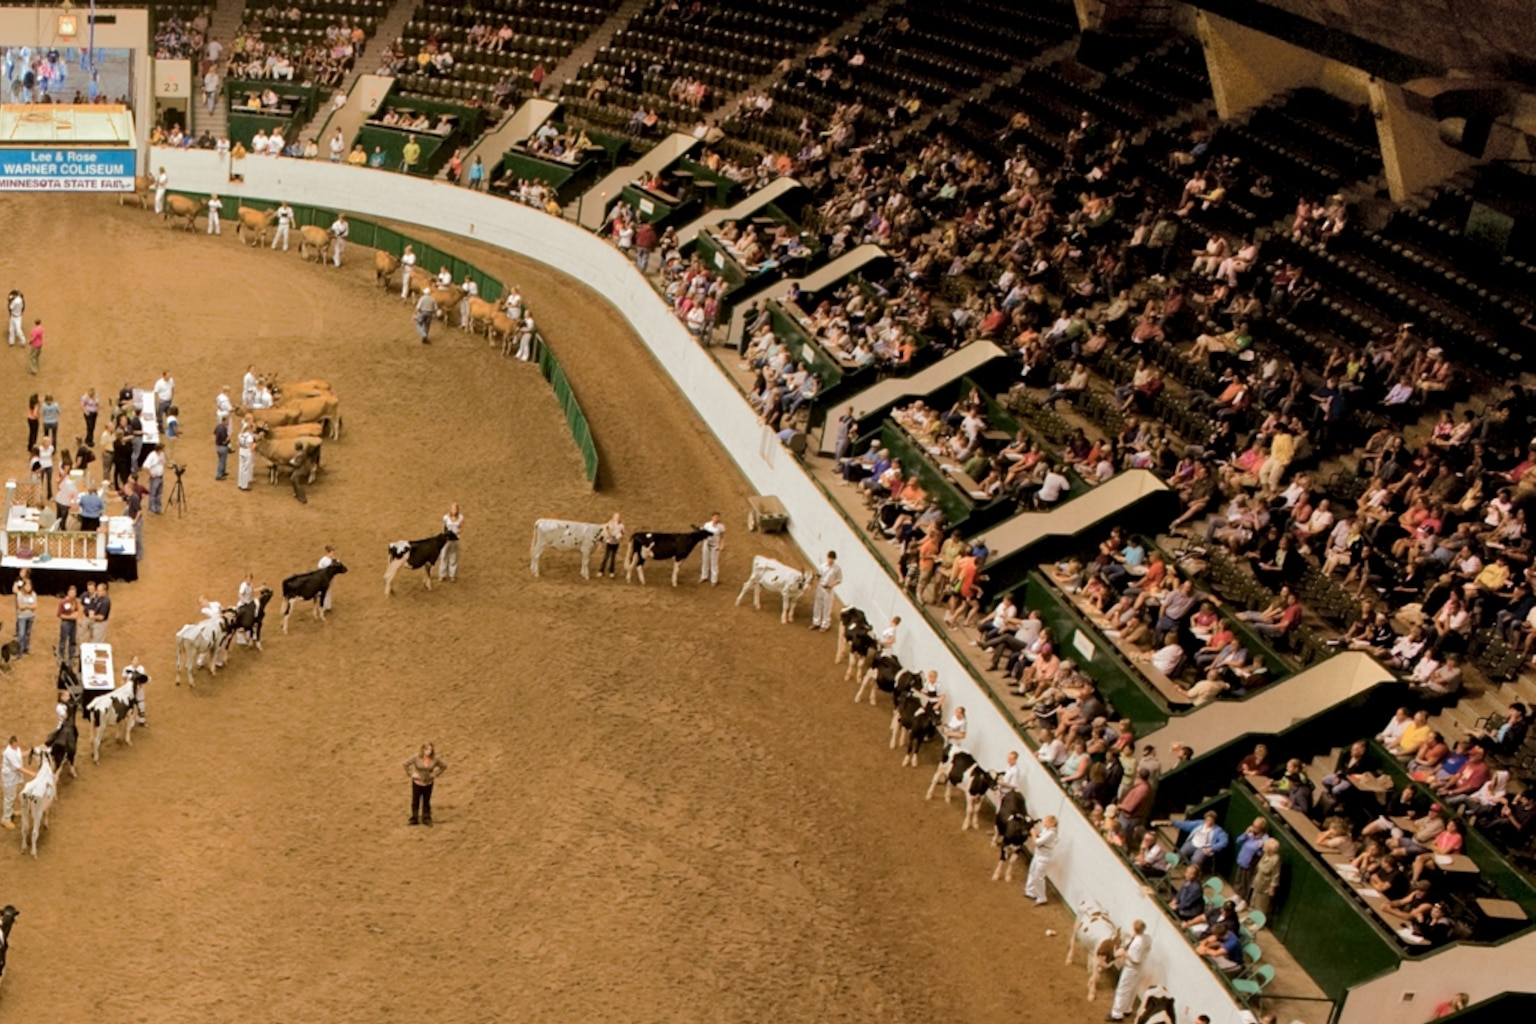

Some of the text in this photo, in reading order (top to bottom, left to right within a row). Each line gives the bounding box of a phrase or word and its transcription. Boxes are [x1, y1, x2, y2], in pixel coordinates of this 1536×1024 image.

[164, 82, 179, 92] 23
[370, 98, 377, 108] 2
[31, 151, 97, 162] Lee & Rose
[3, 163, 124, 175] WARNER COLISEUM
[64, 179, 97, 188] STATE
